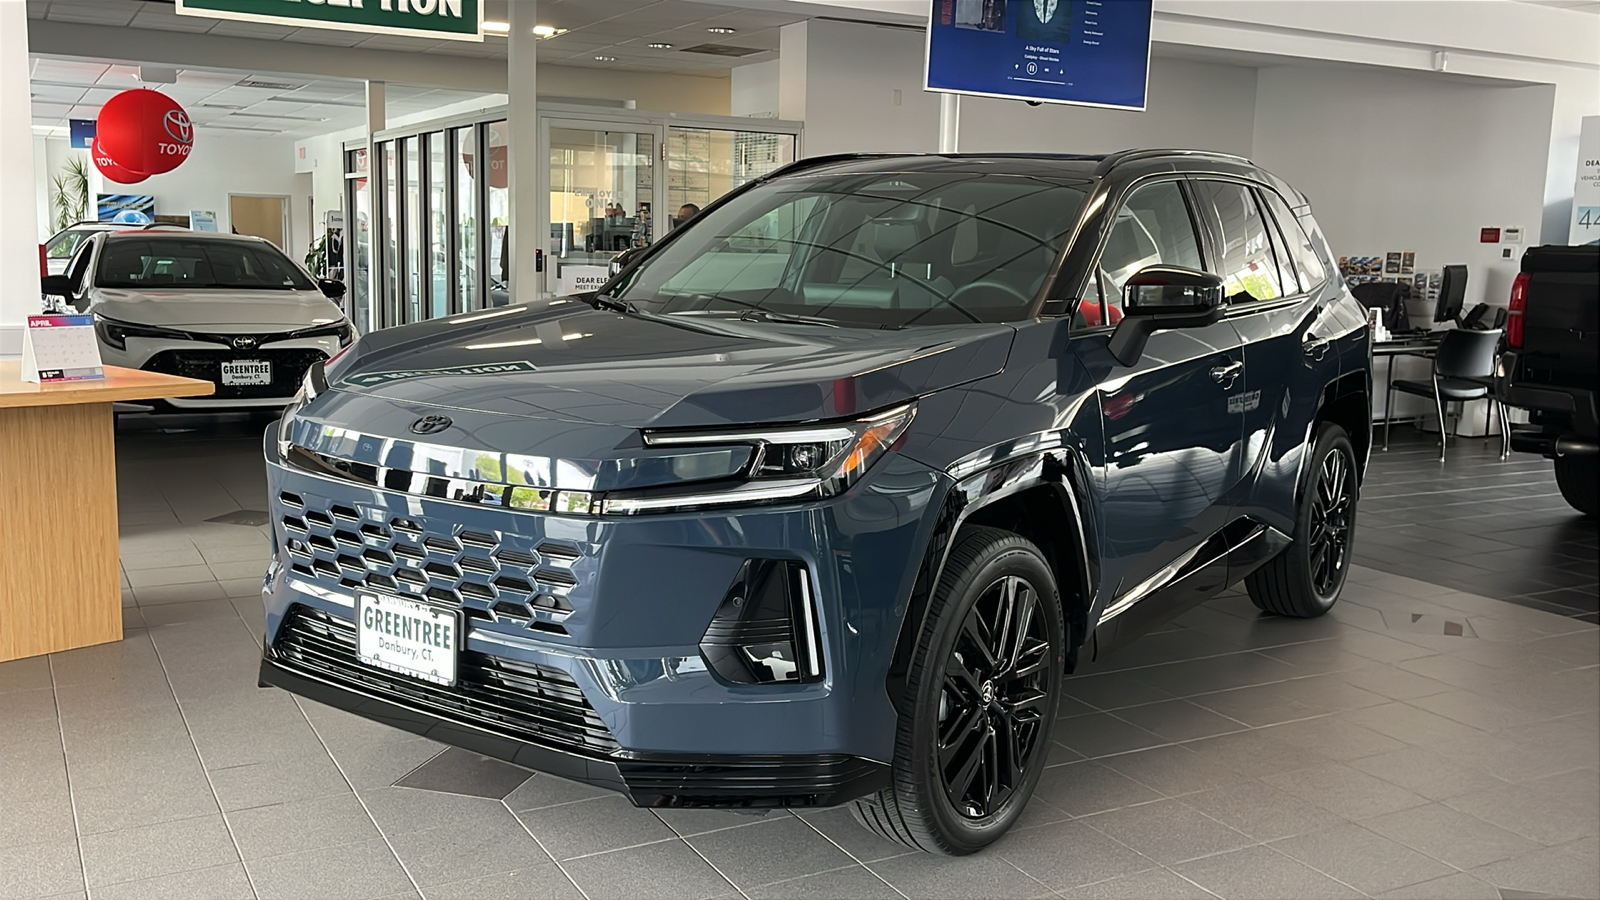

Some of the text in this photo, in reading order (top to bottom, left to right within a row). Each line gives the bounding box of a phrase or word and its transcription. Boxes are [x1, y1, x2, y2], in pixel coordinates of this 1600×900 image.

[158, 142, 192, 155] TOYO
[30, 319, 52, 327] APRIL
[223, 364, 269, 374] GREENTREE
[363, 605, 451, 650] GREENTREE
[378, 636, 434, 662] Danbury, CT.
